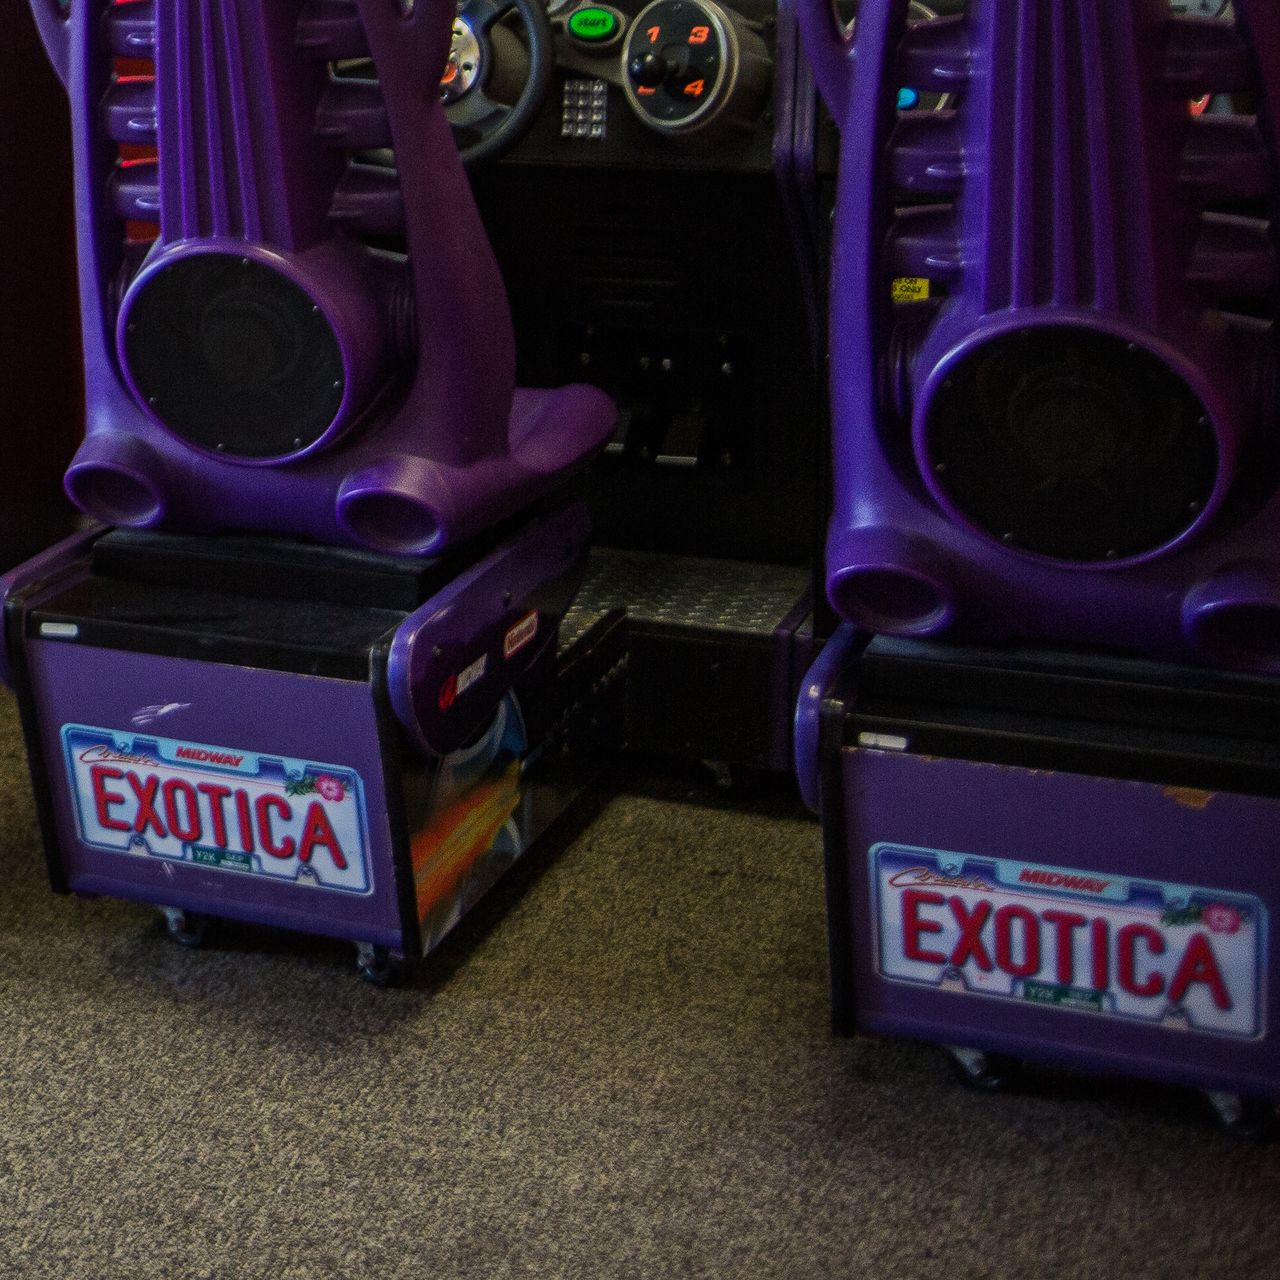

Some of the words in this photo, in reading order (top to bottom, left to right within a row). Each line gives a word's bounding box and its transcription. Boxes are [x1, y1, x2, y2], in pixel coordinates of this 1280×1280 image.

[647, 25, 660, 44] 1
[688, 25, 710, 44] 3
[684, 78, 705, 98] 4
[176, 745, 244, 767] MIDWAY
[92, 764, 347, 870] EXOTICA
[1019, 868, 1110, 893] MIDWAY
[901, 889, 1231, 1011] EXOTICA
